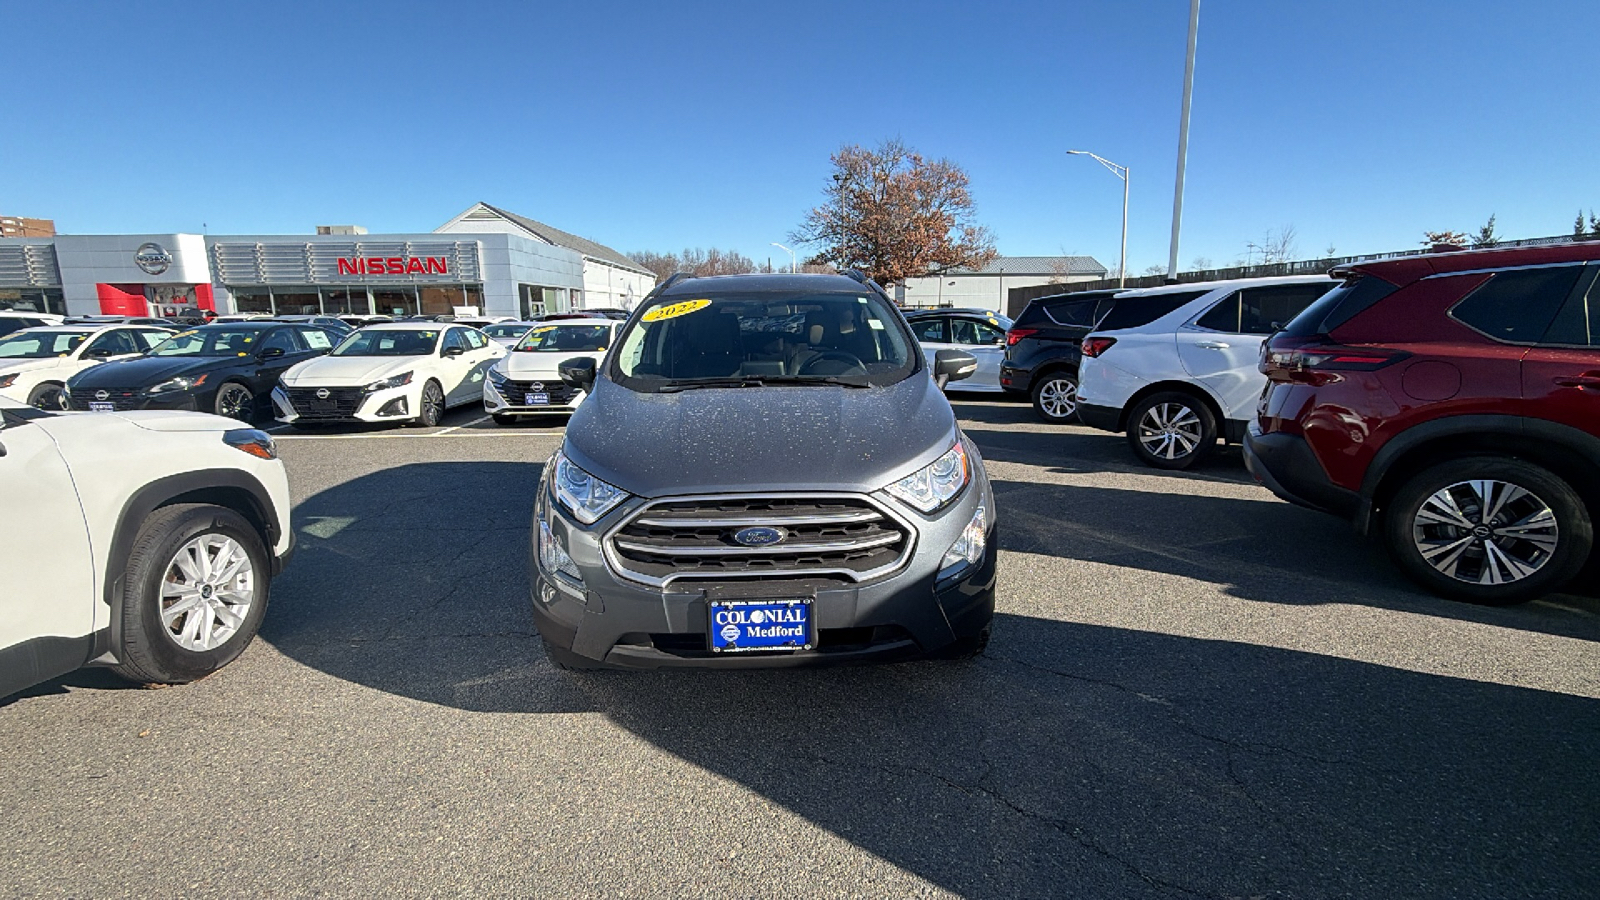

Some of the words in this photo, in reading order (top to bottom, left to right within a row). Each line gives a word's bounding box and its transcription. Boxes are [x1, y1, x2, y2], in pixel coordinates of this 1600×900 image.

[337, 256, 448, 275] NISSAN
[655, 301, 697, 318] 2022
[745, 531, 773, 543] Ford
[716, 609, 806, 625] COLONIAL
[747, 625, 803, 637] Medford
